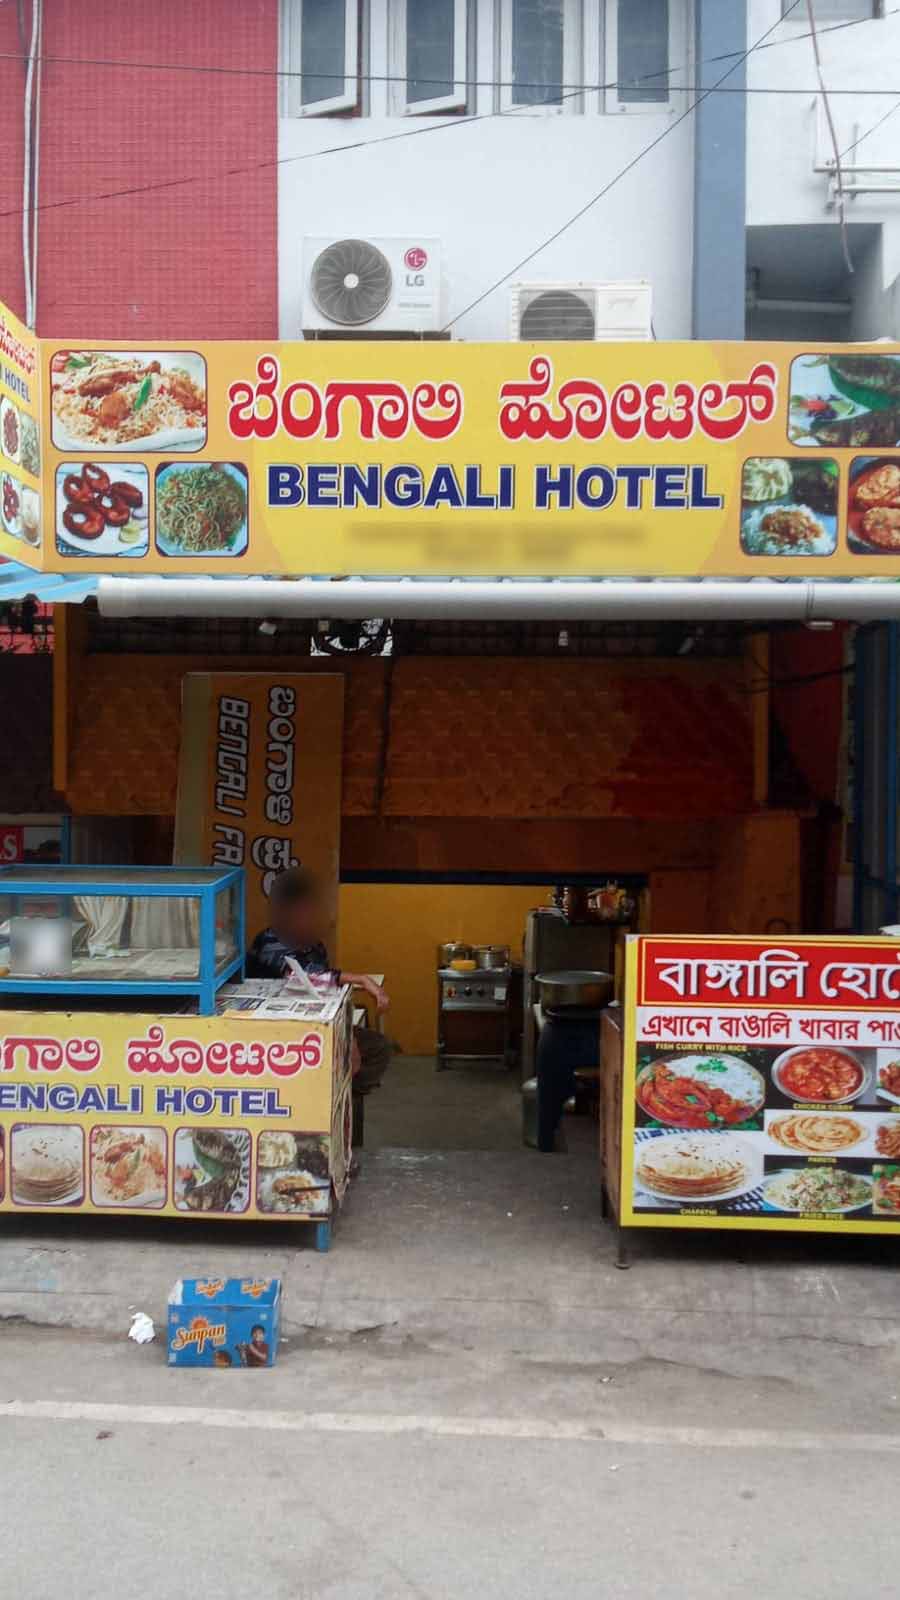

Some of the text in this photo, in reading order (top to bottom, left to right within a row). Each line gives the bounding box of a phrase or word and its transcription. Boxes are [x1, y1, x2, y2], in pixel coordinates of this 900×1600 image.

[406, 274, 425, 287] LG
[4, 367, 32, 402] HOTEL
[228, 355, 777, 440] ಬೆಂಗಾಲಿ ಹೋಟಲ್
[268, 464, 724, 510] BENGALI HOTEL
[213, 696, 249, 866] BENGALI FA
[654, 948, 809, 999] বাঙ্গালি
[642, 1014, 713, 1038] এখানে
[718, 1011, 792, 1040] বাঙালি
[799, 1018, 860, 1041] খাবার
[0, 1025, 322, 1076] ಗಾಲಿ ಹೋಟಲ್
[656, 1042, 674, 1051] FISH
[676, 1043, 703, 1051] CURRY
[705, 1043, 727, 1052] WITH
[0, 1085, 290, 1117] ENGALI HOTEL
[171, 1325, 226, 1353] Sunpan
